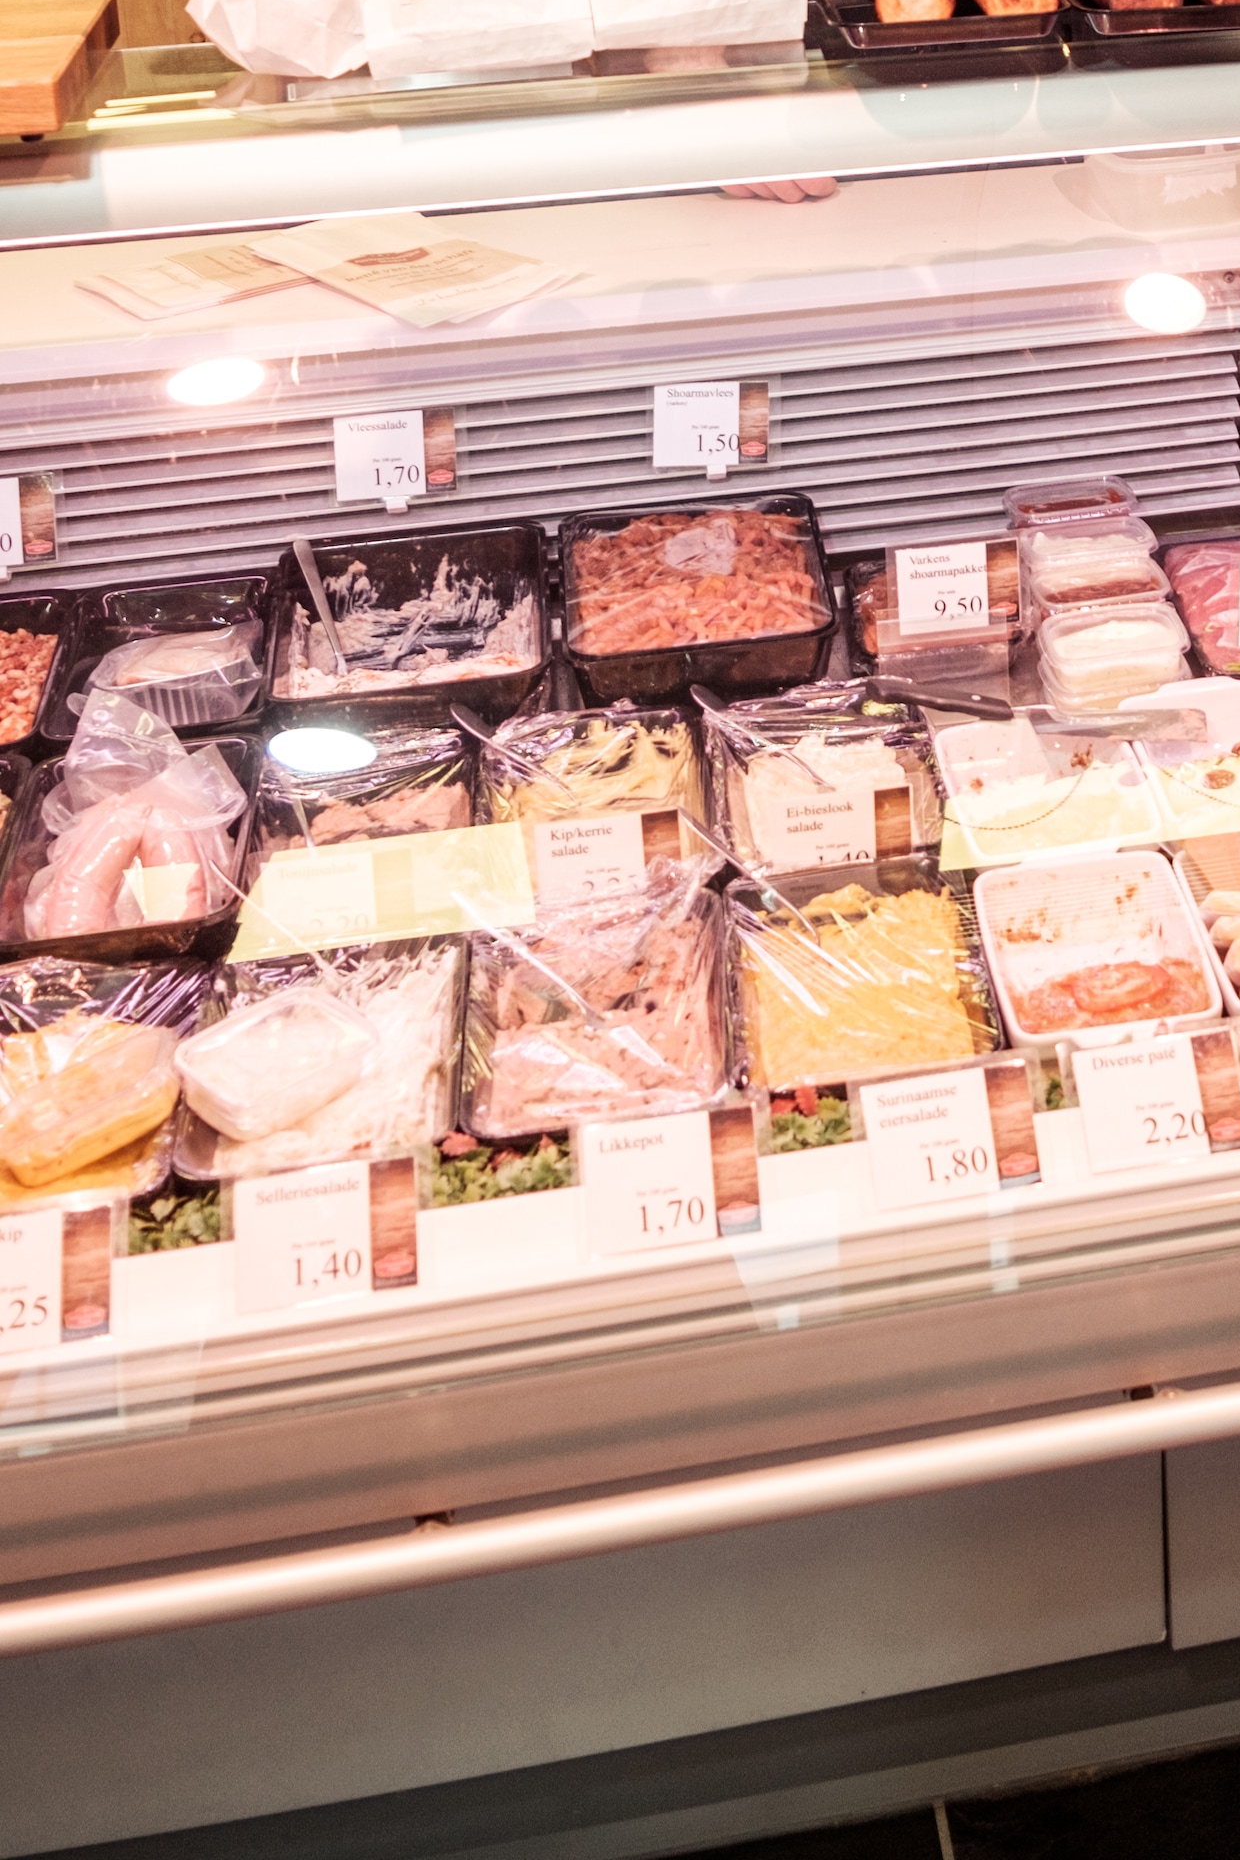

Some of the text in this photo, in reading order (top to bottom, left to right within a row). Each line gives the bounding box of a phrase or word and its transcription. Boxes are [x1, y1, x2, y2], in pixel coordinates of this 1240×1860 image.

[667, 388, 735, 398] Shoarmavlees
[348, 420, 408, 432] Vleessalade
[697, 433, 740, 456] 1,50
[374, 464, 420, 488] 1,70
[909, 554, 951, 565] Varkens
[909, 564, 988, 580] shoarmapakket
[934, 595, 983, 620] 9,50
[786, 801, 854, 818] Ei-bieslook
[550, 824, 613, 841] Kip/kerrie
[786, 821, 824, 834] salade
[551, 843, 589, 858] salade
[1092, 1053, 1144, 1071] Diverse
[876, 1085, 958, 1109] Surinaamse
[879, 1105, 949, 1129] eiersalade
[1142, 1109, 1206, 1147] 2,20
[599, 1134, 664, 1154] Likkepot
[926, 1146, 988, 1184] 1,80
[256, 1177, 360, 1206] Selleriesalade
[640, 1196, 704, 1236] 1,70
[295, 1249, 362, 1290] 1,40
